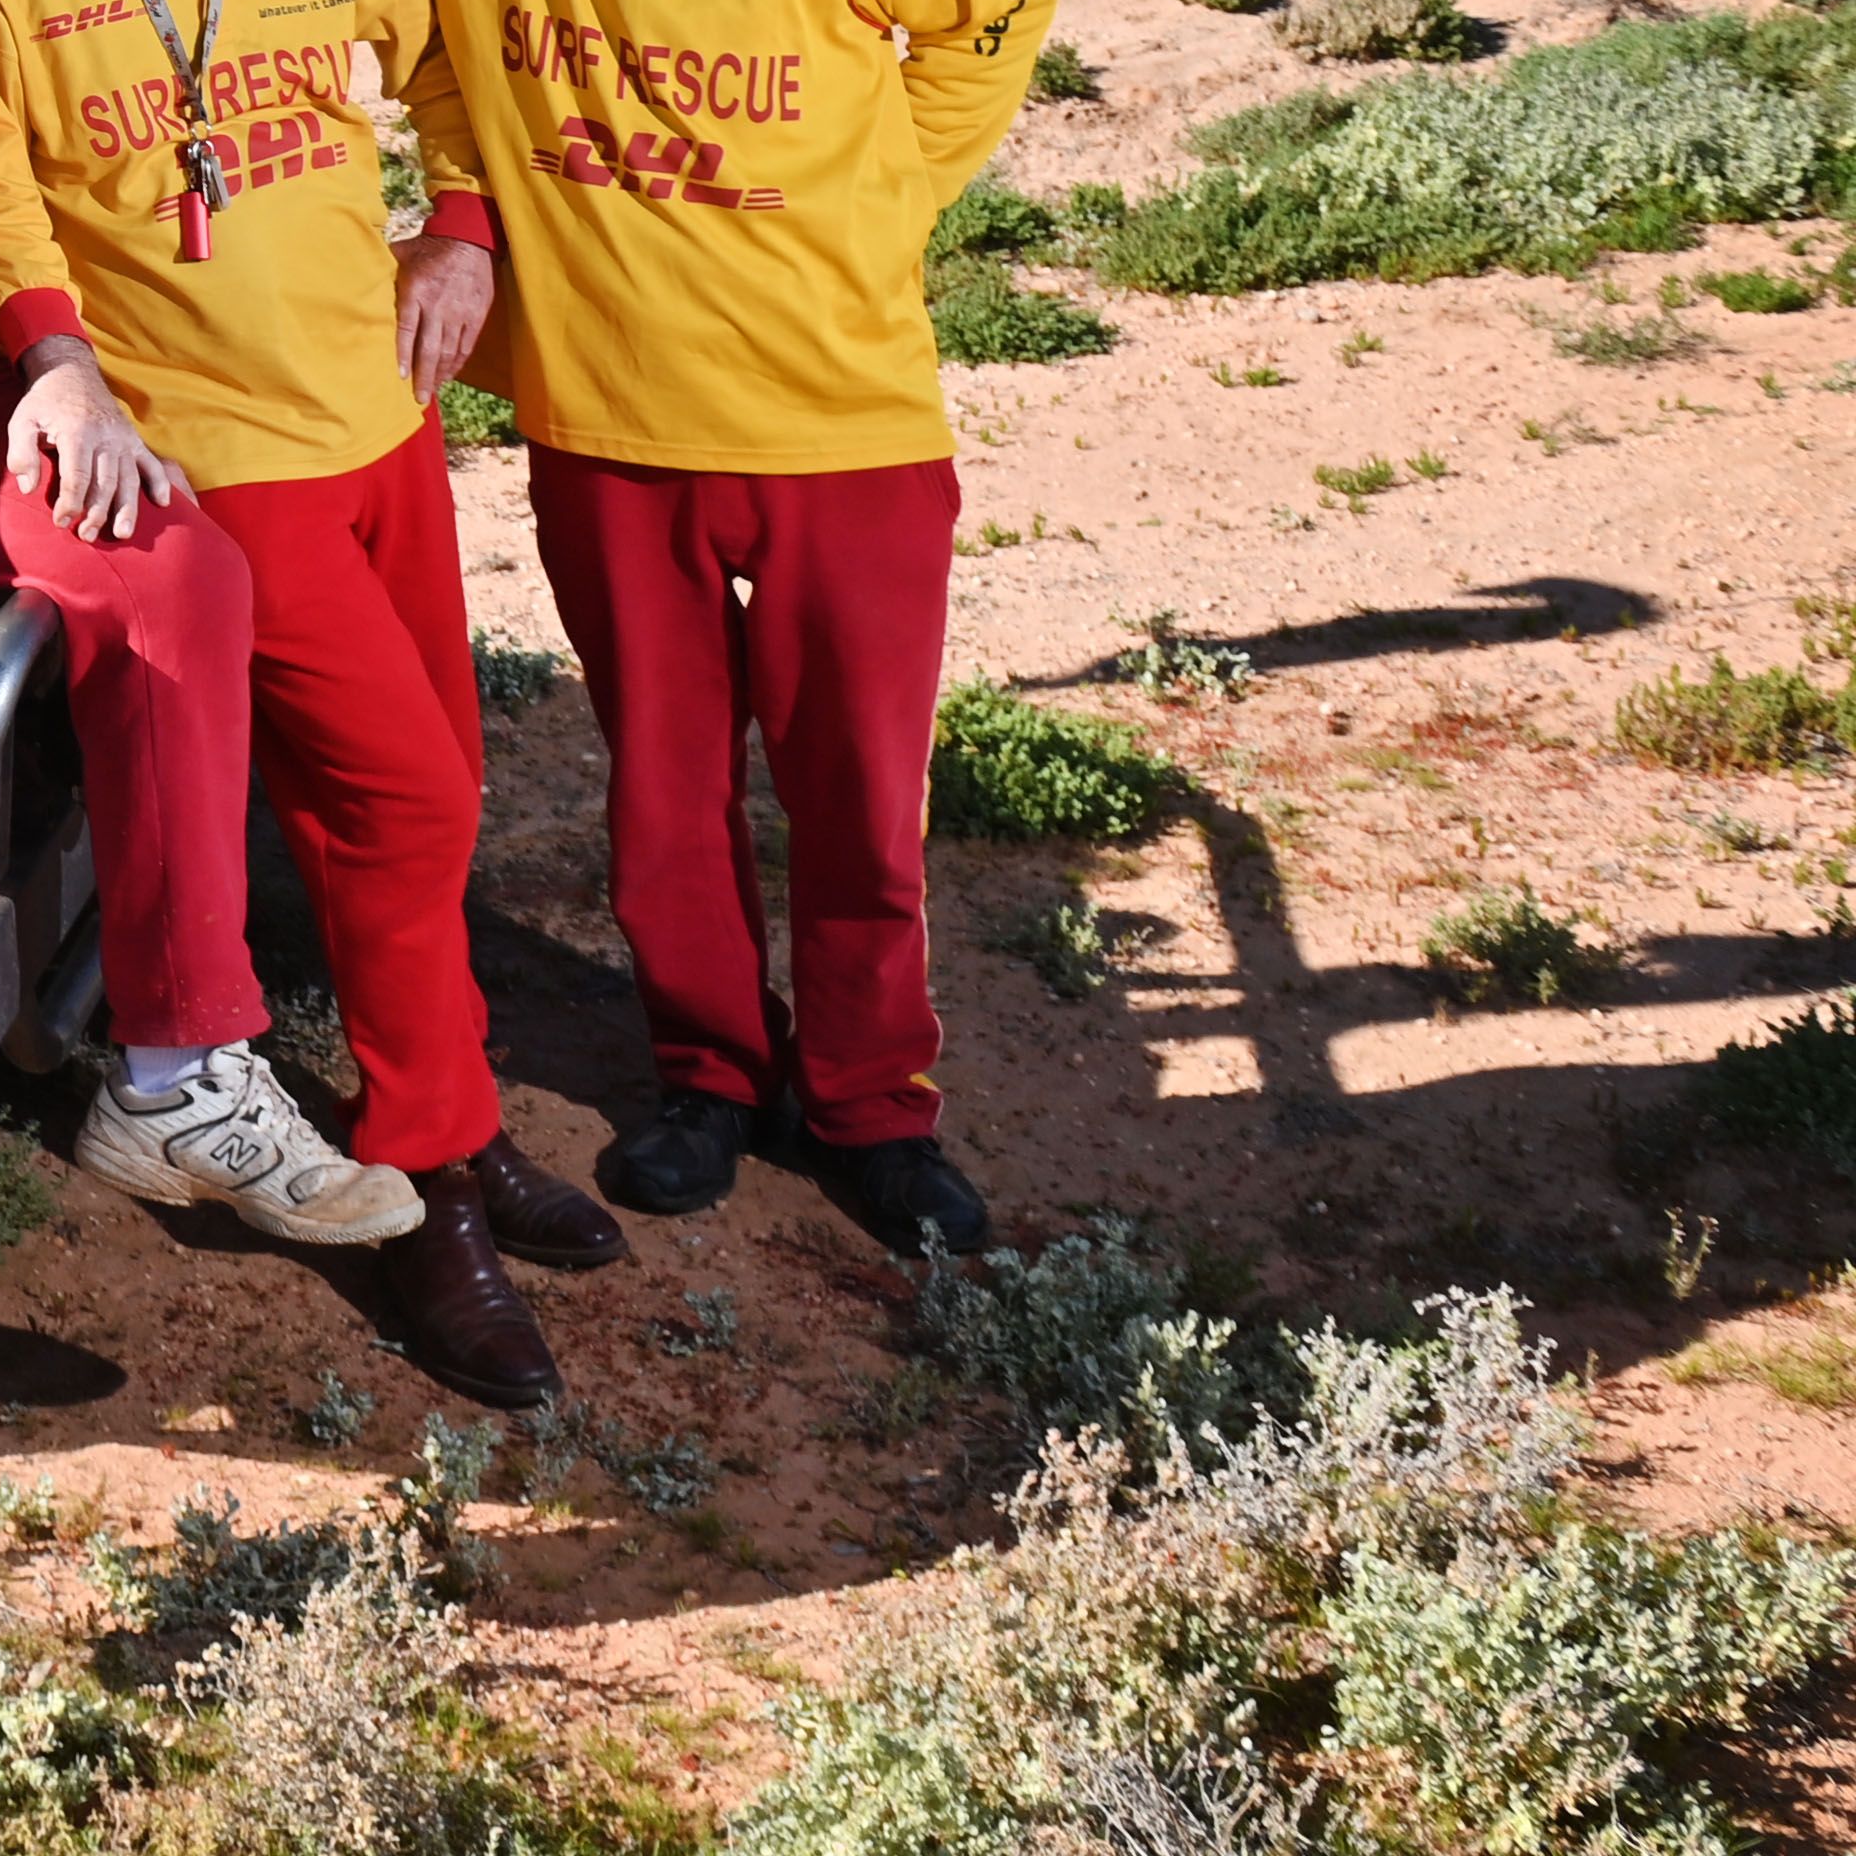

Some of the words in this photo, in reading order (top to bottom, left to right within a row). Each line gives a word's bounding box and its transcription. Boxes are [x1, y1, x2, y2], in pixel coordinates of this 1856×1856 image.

[40, 0, 136, 40] DHL
[258, 4, 307, 18] Whatever
[310, 2, 320, 10] it
[207, 39, 352, 123] RESCU
[501, 5, 603, 90] SURF
[616, 36, 801, 124] RESCUE
[557, 115, 744, 210] DHL
